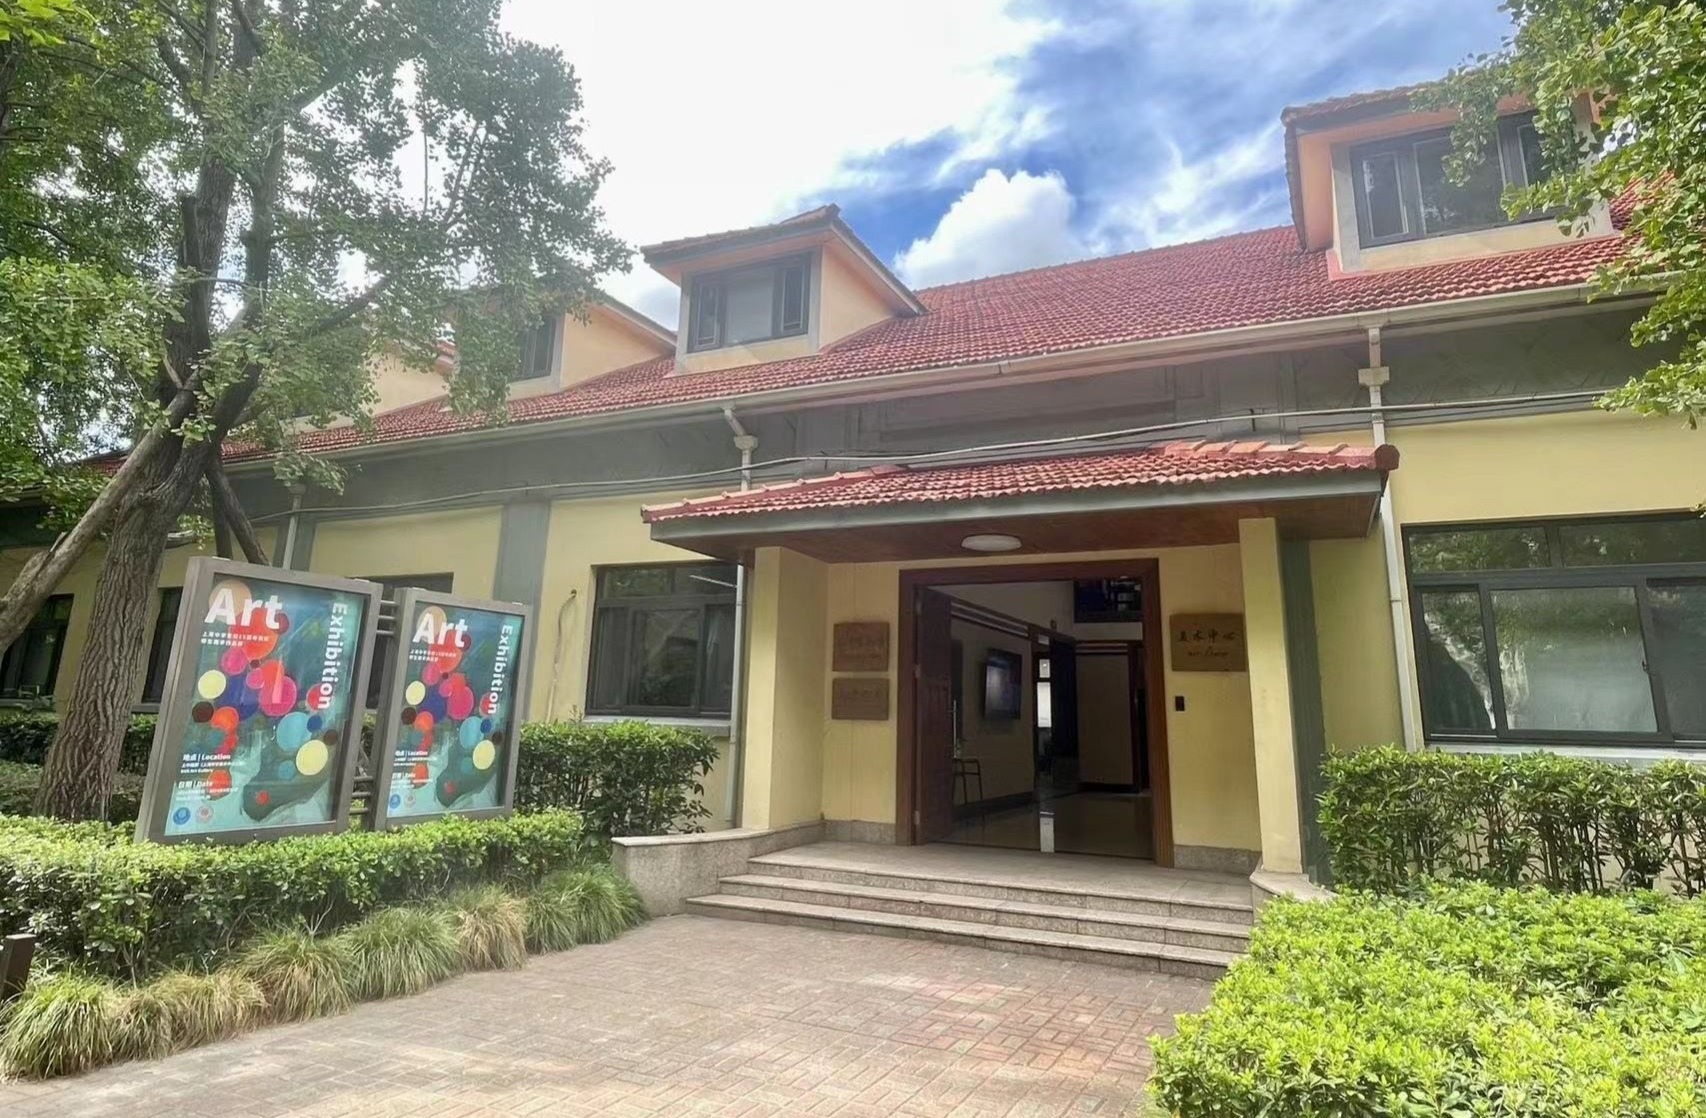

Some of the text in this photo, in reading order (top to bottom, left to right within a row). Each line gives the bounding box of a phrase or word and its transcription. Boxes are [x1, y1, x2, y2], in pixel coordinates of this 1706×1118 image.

[204, 587, 283, 630] Art
[412, 612, 468, 648] Art
[317, 602, 348, 710] Exhibition
[487, 624, 514, 715] Exhibition
[201, 753, 231, 761] Location
